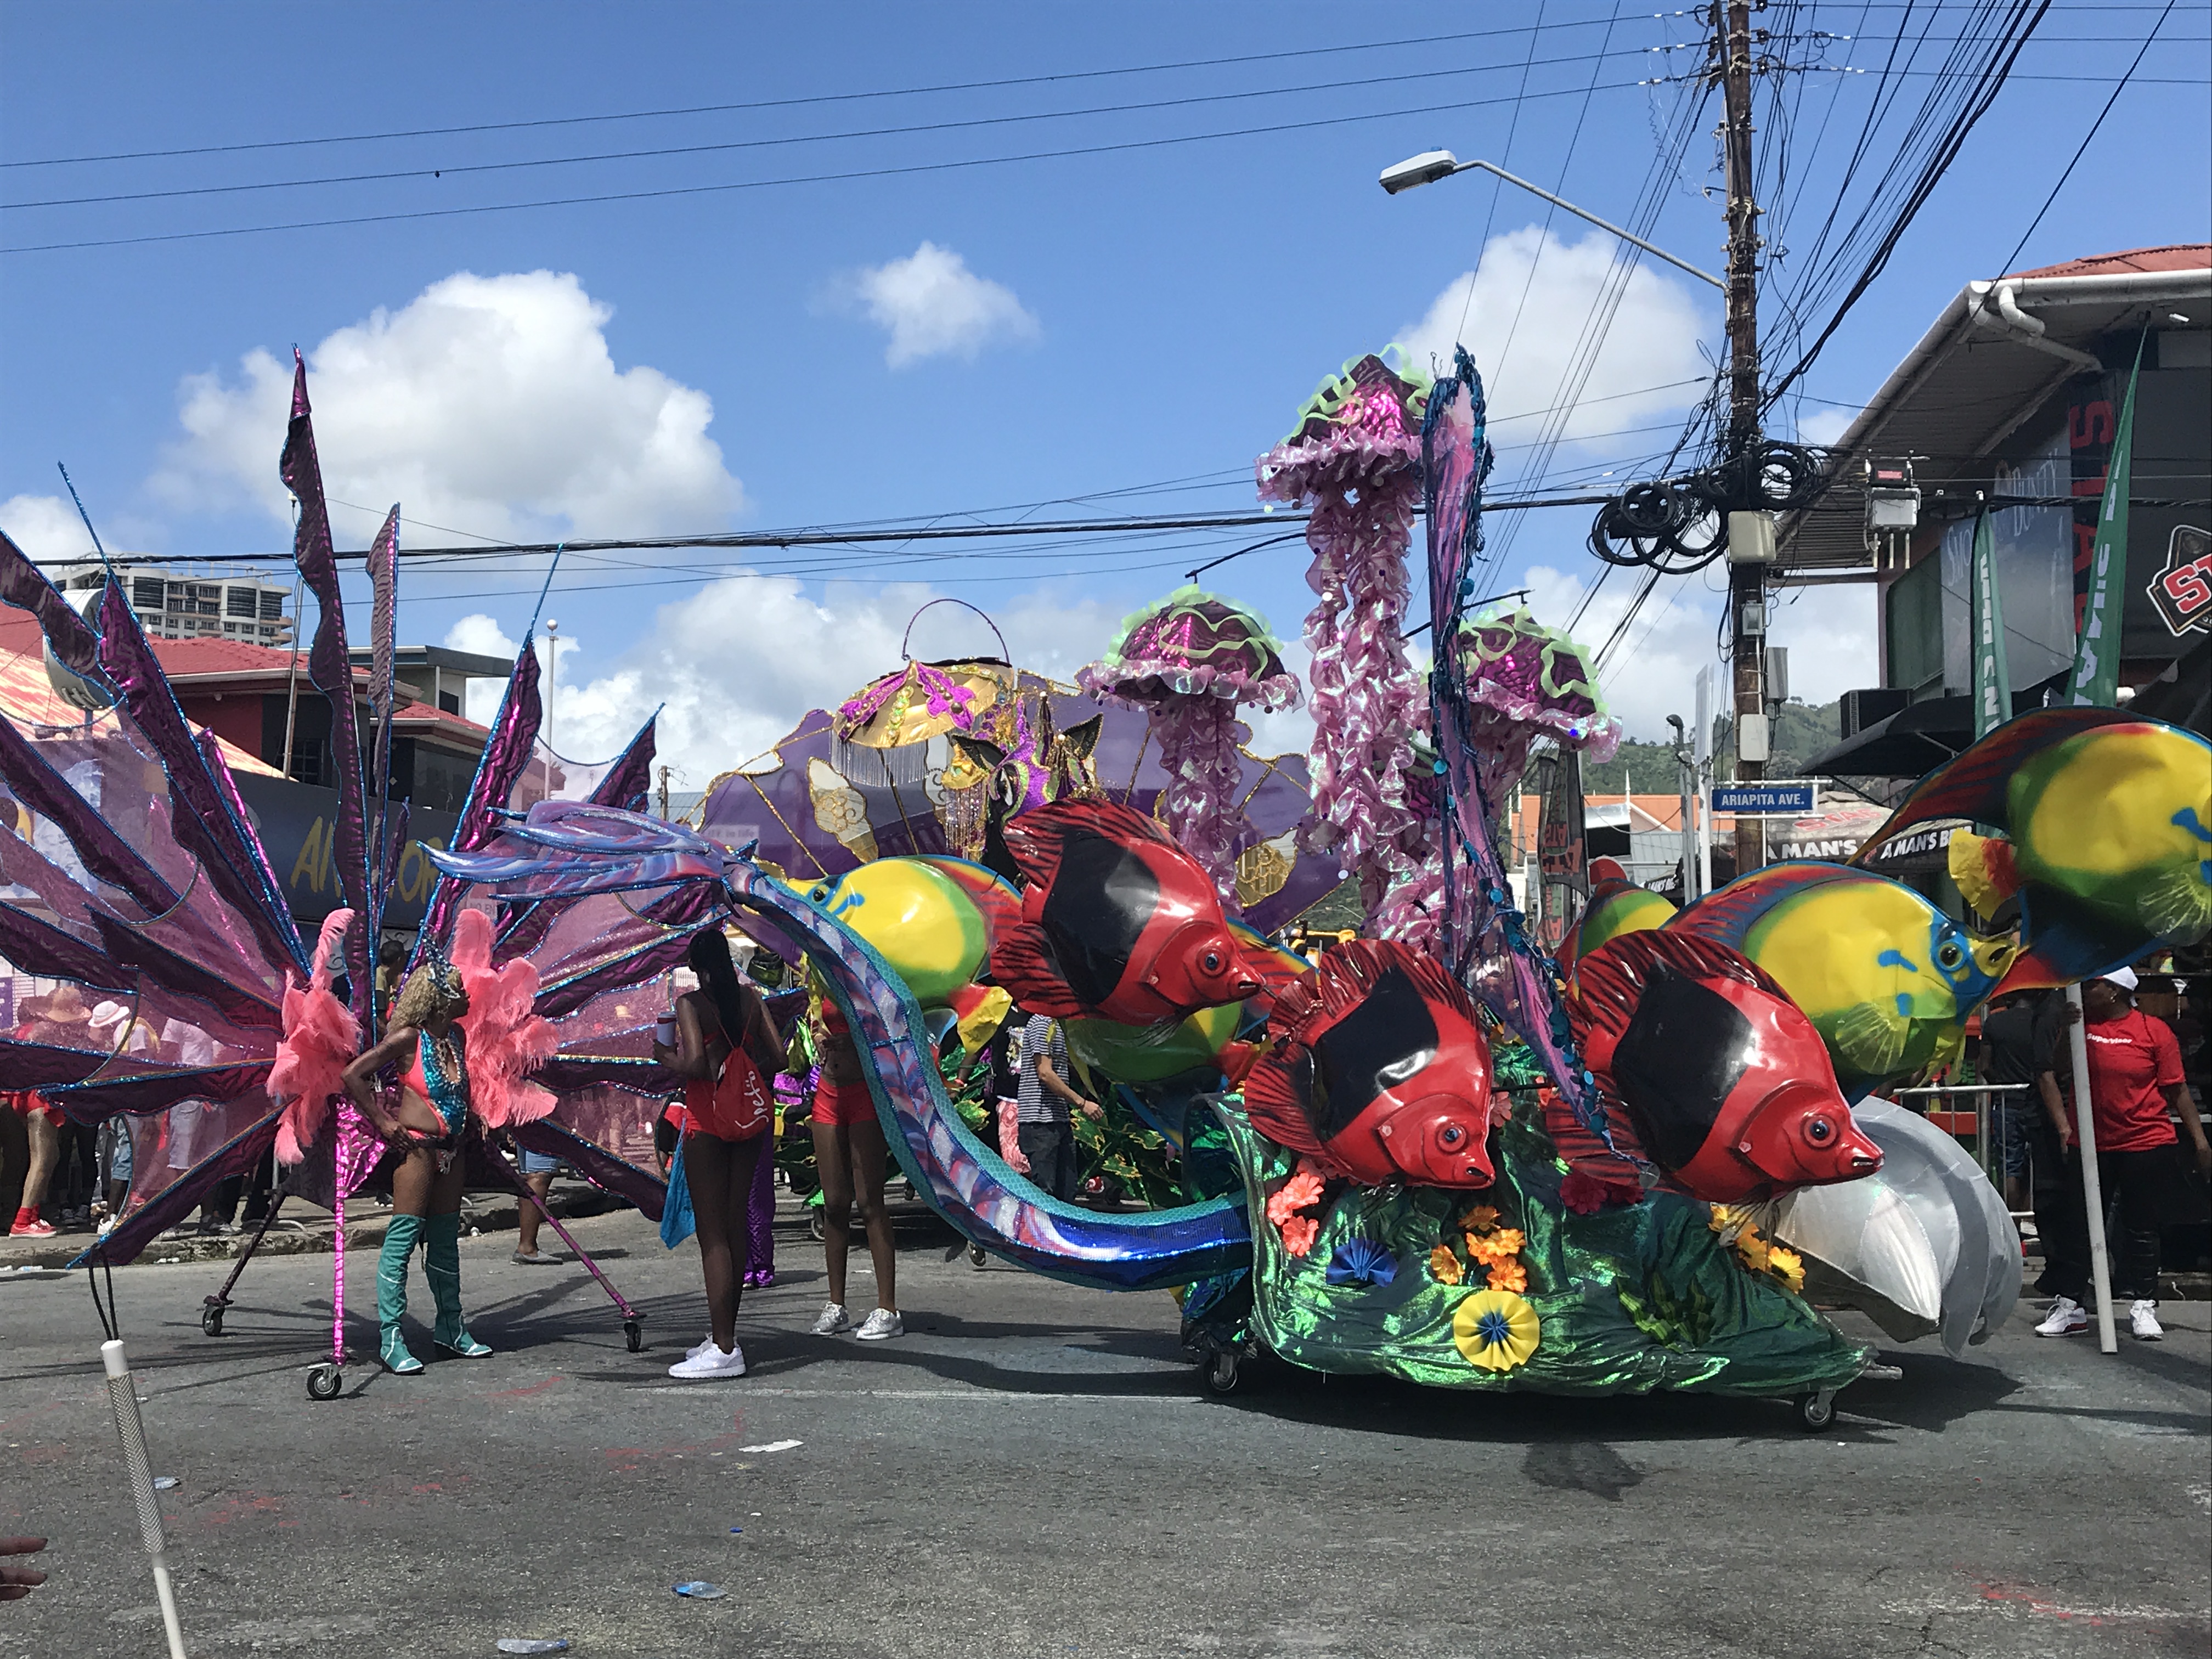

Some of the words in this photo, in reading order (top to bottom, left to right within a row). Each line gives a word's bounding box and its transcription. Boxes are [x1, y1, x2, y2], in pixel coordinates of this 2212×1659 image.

[1722, 794, 1775, 805] ARIAPITA
[1779, 793, 1804, 805] AVE.
[1782, 839, 1858, 859] MAN'S
[1880, 843, 1892, 859] A
[1893, 832, 1937, 857] MAN'S
[2086, 1033, 2132, 1044] Supervisor
